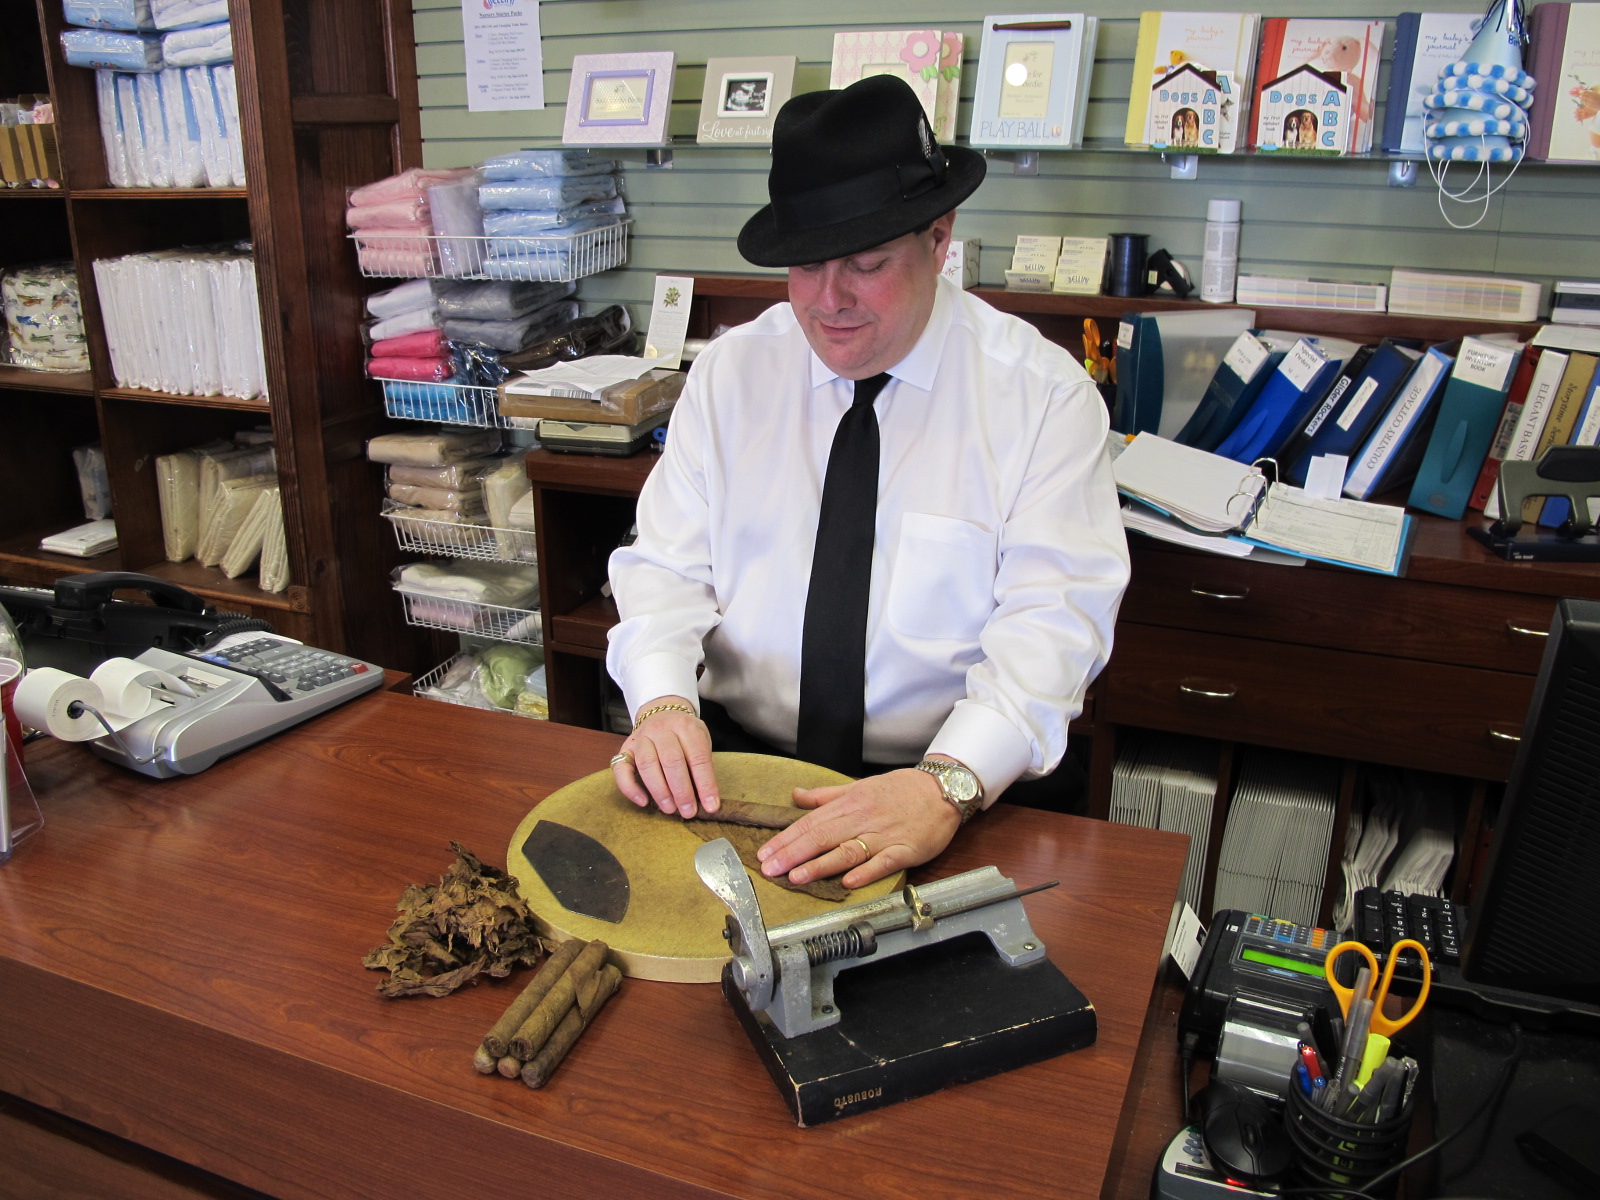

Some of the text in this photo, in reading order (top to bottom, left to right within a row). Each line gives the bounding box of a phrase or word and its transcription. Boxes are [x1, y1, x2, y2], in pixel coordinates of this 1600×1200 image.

[1425, 32, 1469, 45] my baby's
[1426, 42, 1457, 52] journal
[1159, 89, 1199, 105] Dogs
[1269, 90, 1318, 106] Dogs
[702, 120, 734, 141] Love
[735, 126, 743, 136] at
[744, 124, 761, 139] first
[980, 120, 1049, 139] PLAY BALL
[1294, 352, 1311, 370] Orders
[1301, 345, 1318, 363] Special
[1465, 355, 1497, 368] INVENTORY
[1467, 349, 1498, 360] FURNITURE
[1470, 363, 1487, 372] BOOK
[1307, 378, 1349, 433] Glider Rockers
[1526, 382, 1550, 430] ELEGANT
[1545, 382, 1578, 448] Storytime Serie
[1366, 385, 1422, 470] COUNTRY COTTAGE
[833, 1086, 883, 1107] ROBUSTO
